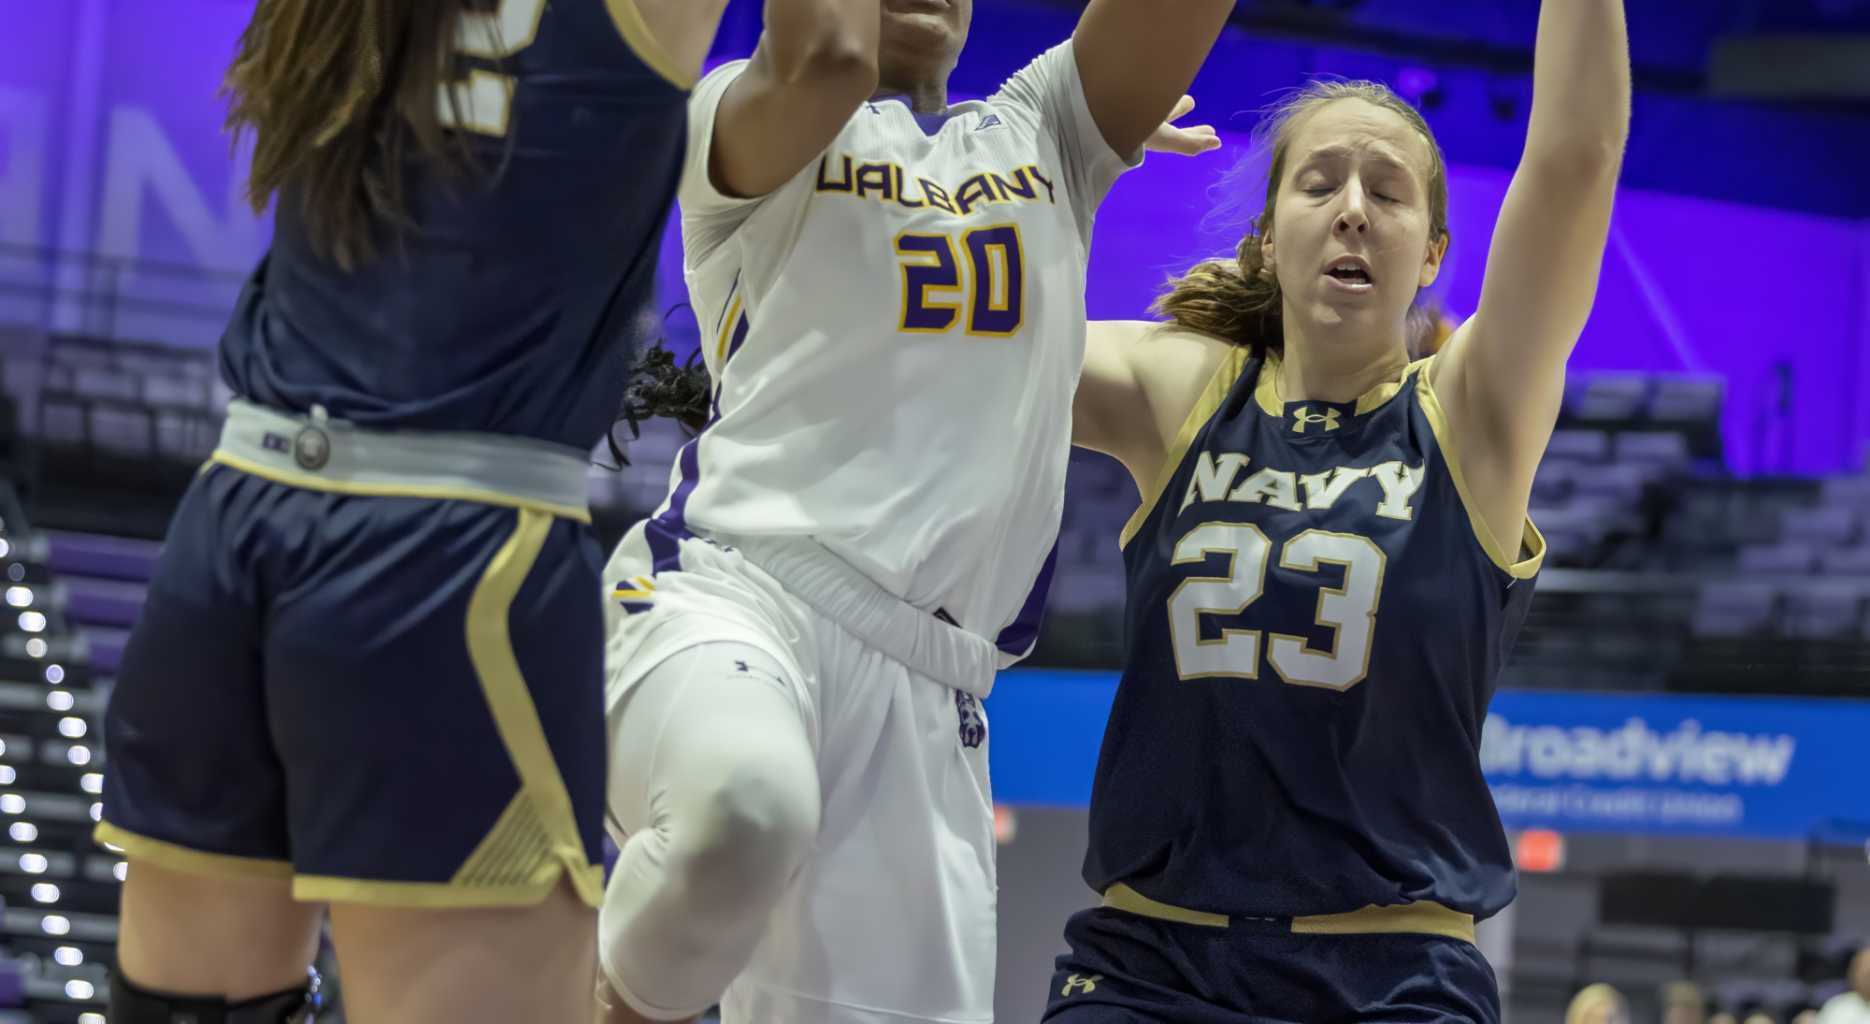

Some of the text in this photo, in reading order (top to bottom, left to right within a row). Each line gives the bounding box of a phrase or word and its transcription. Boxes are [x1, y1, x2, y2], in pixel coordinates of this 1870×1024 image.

[815, 154, 1055, 216] UALBANY
[893, 223, 1024, 337] 20
[1178, 450, 1425, 520] NAVY
[1167, 521, 1387, 692] 23
